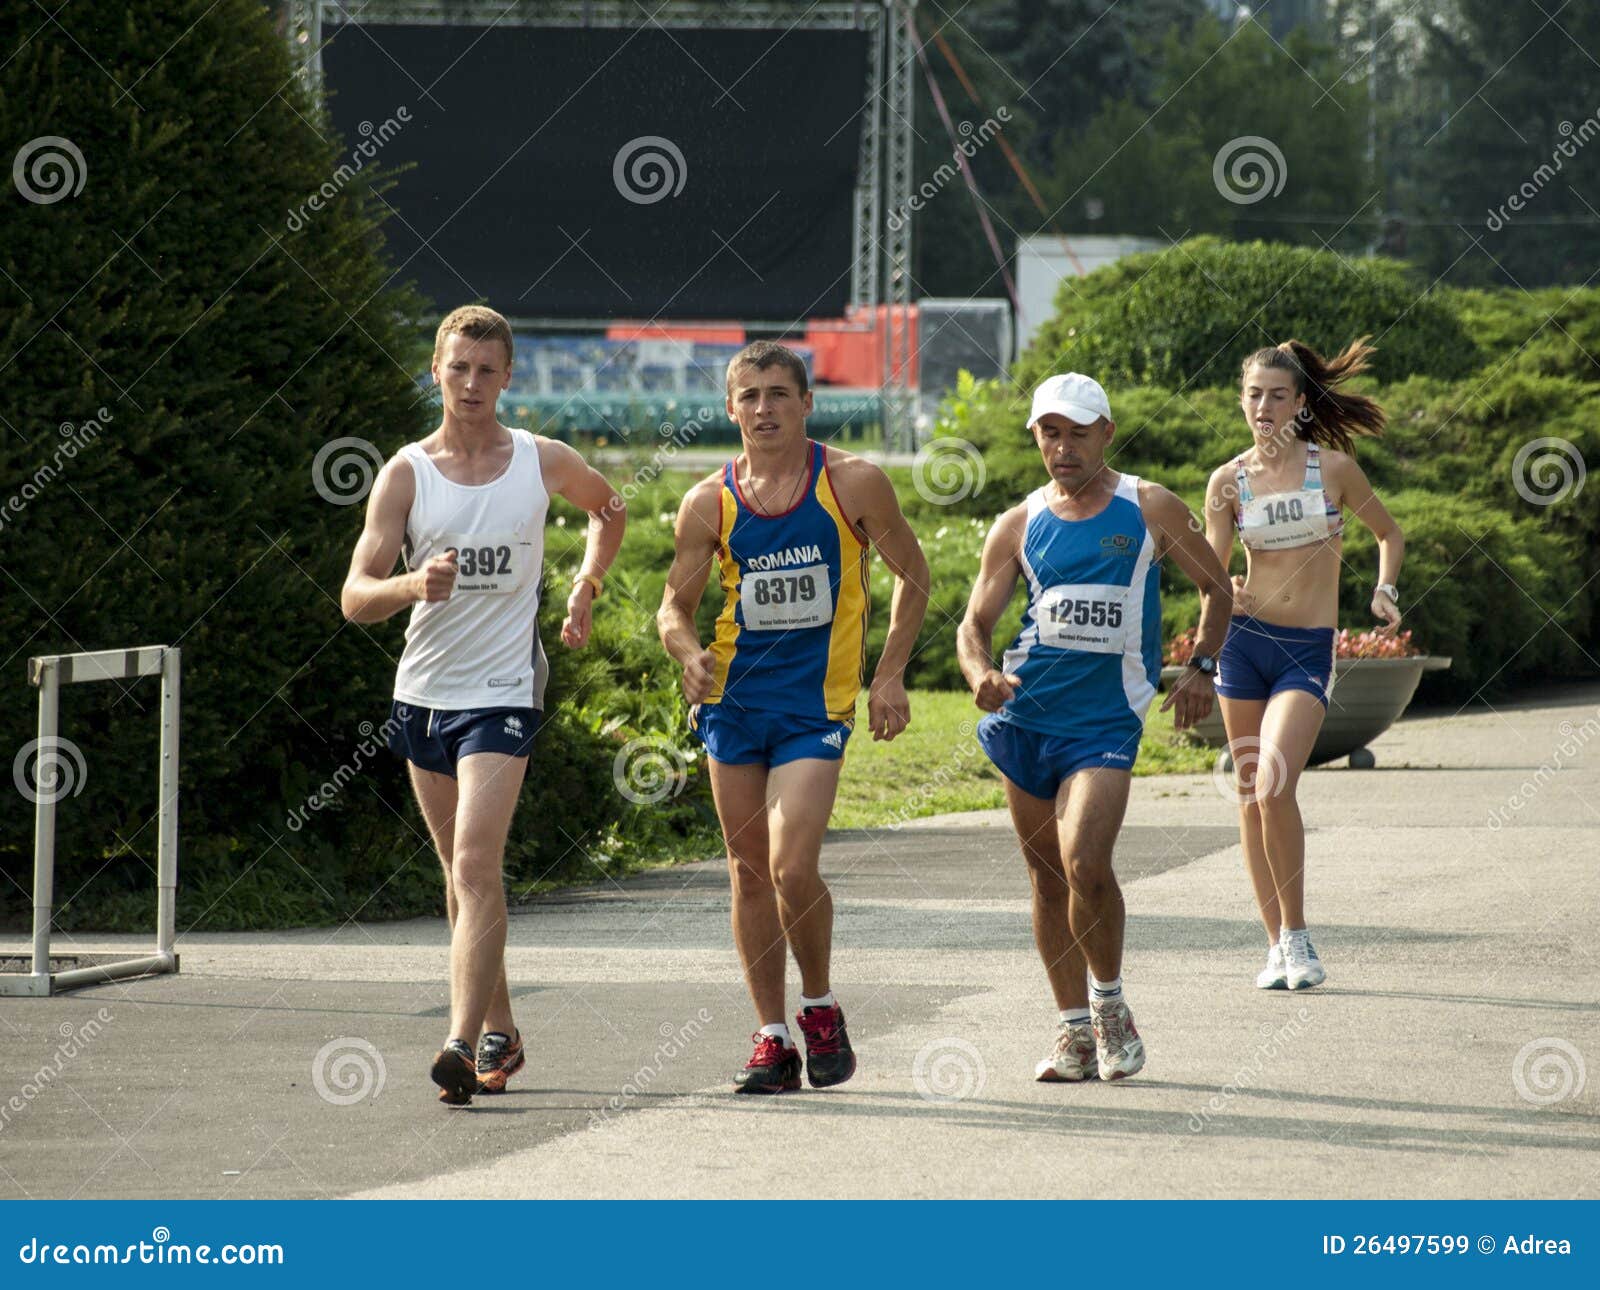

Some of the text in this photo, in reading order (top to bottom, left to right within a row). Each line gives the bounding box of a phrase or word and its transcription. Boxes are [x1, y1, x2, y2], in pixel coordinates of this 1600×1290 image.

[1264, 498, 1303, 525] 140
[748, 544, 823, 571] ROMANIA
[754, 574, 817, 605] 8379
[1050, 599, 1122, 629] 12555
